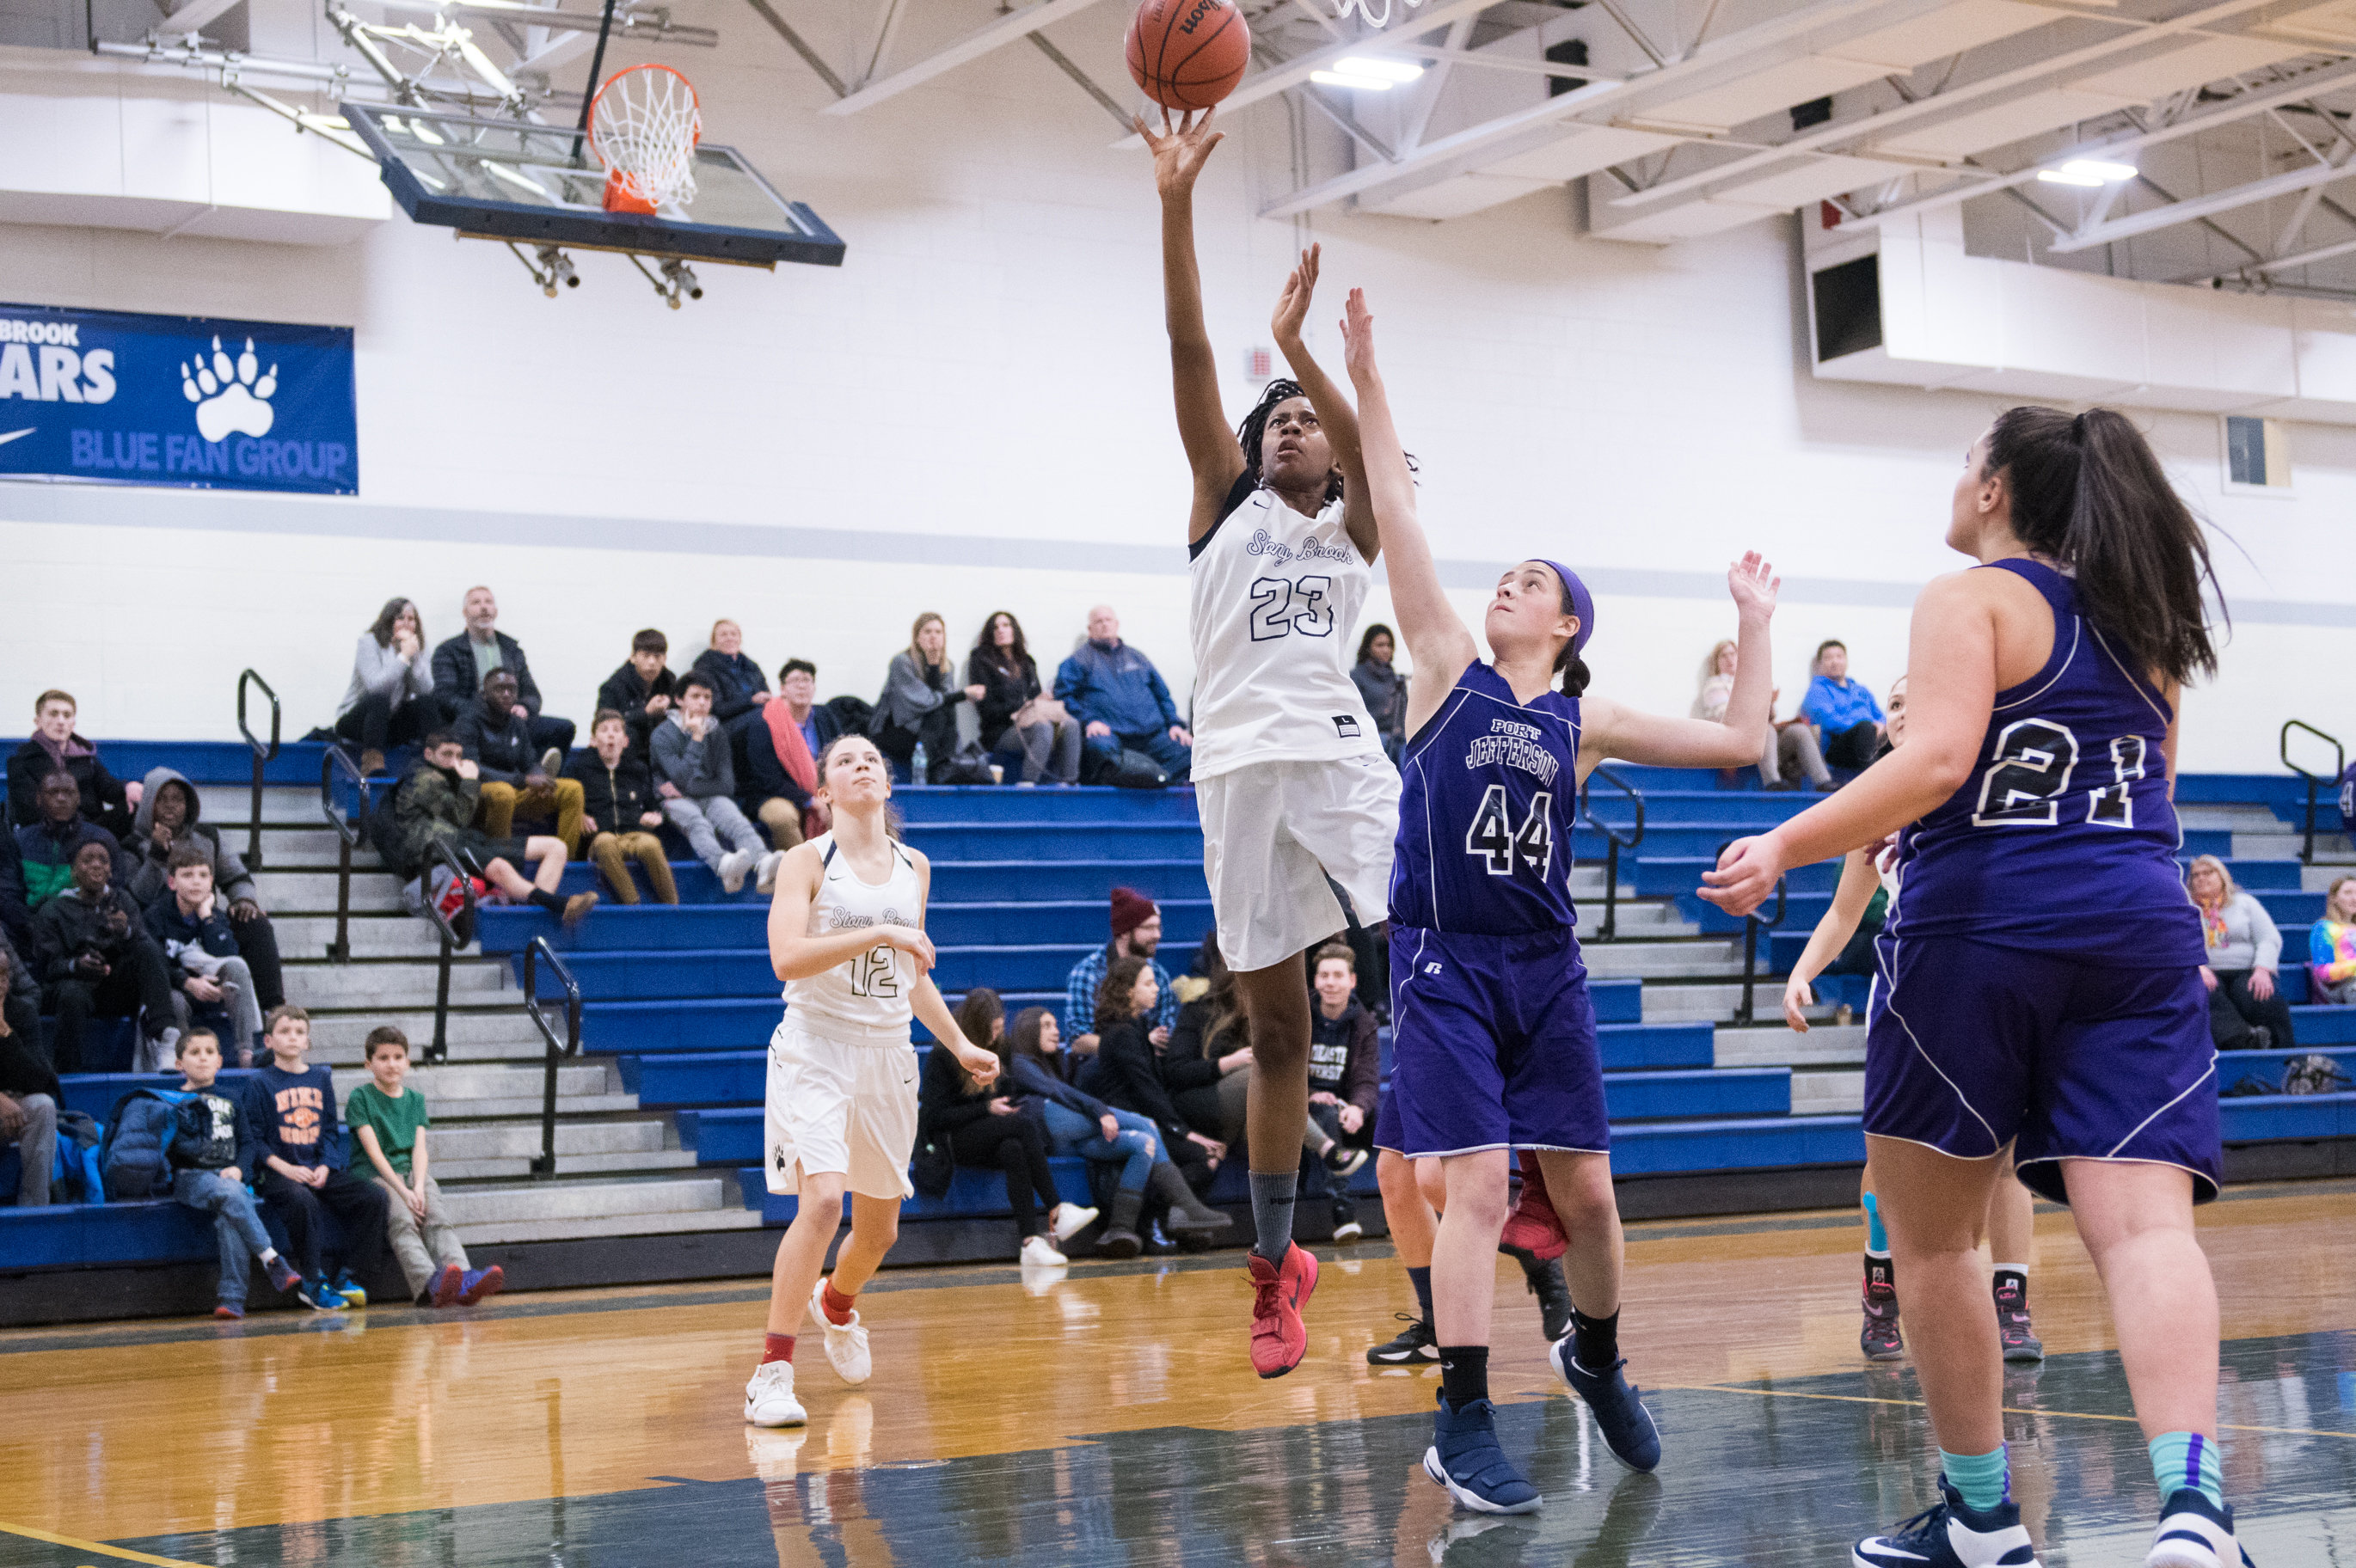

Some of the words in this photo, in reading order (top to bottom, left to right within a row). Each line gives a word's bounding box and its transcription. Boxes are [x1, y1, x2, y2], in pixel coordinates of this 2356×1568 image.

[0, 319, 79, 346] BROOK
[71, 430, 159, 470] BLUE
[166, 434, 229, 474] FAN
[235, 440, 346, 480] GROUP
[1296, 536, 1353, 565] Brook
[1250, 575, 1333, 641] 23
[1491, 719, 1541, 740] PORT
[1466, 735, 1559, 787] JEFFERSON
[1972, 718, 2146, 828] 21
[1466, 784, 1554, 883] 44
[850, 946, 898, 998] 12
